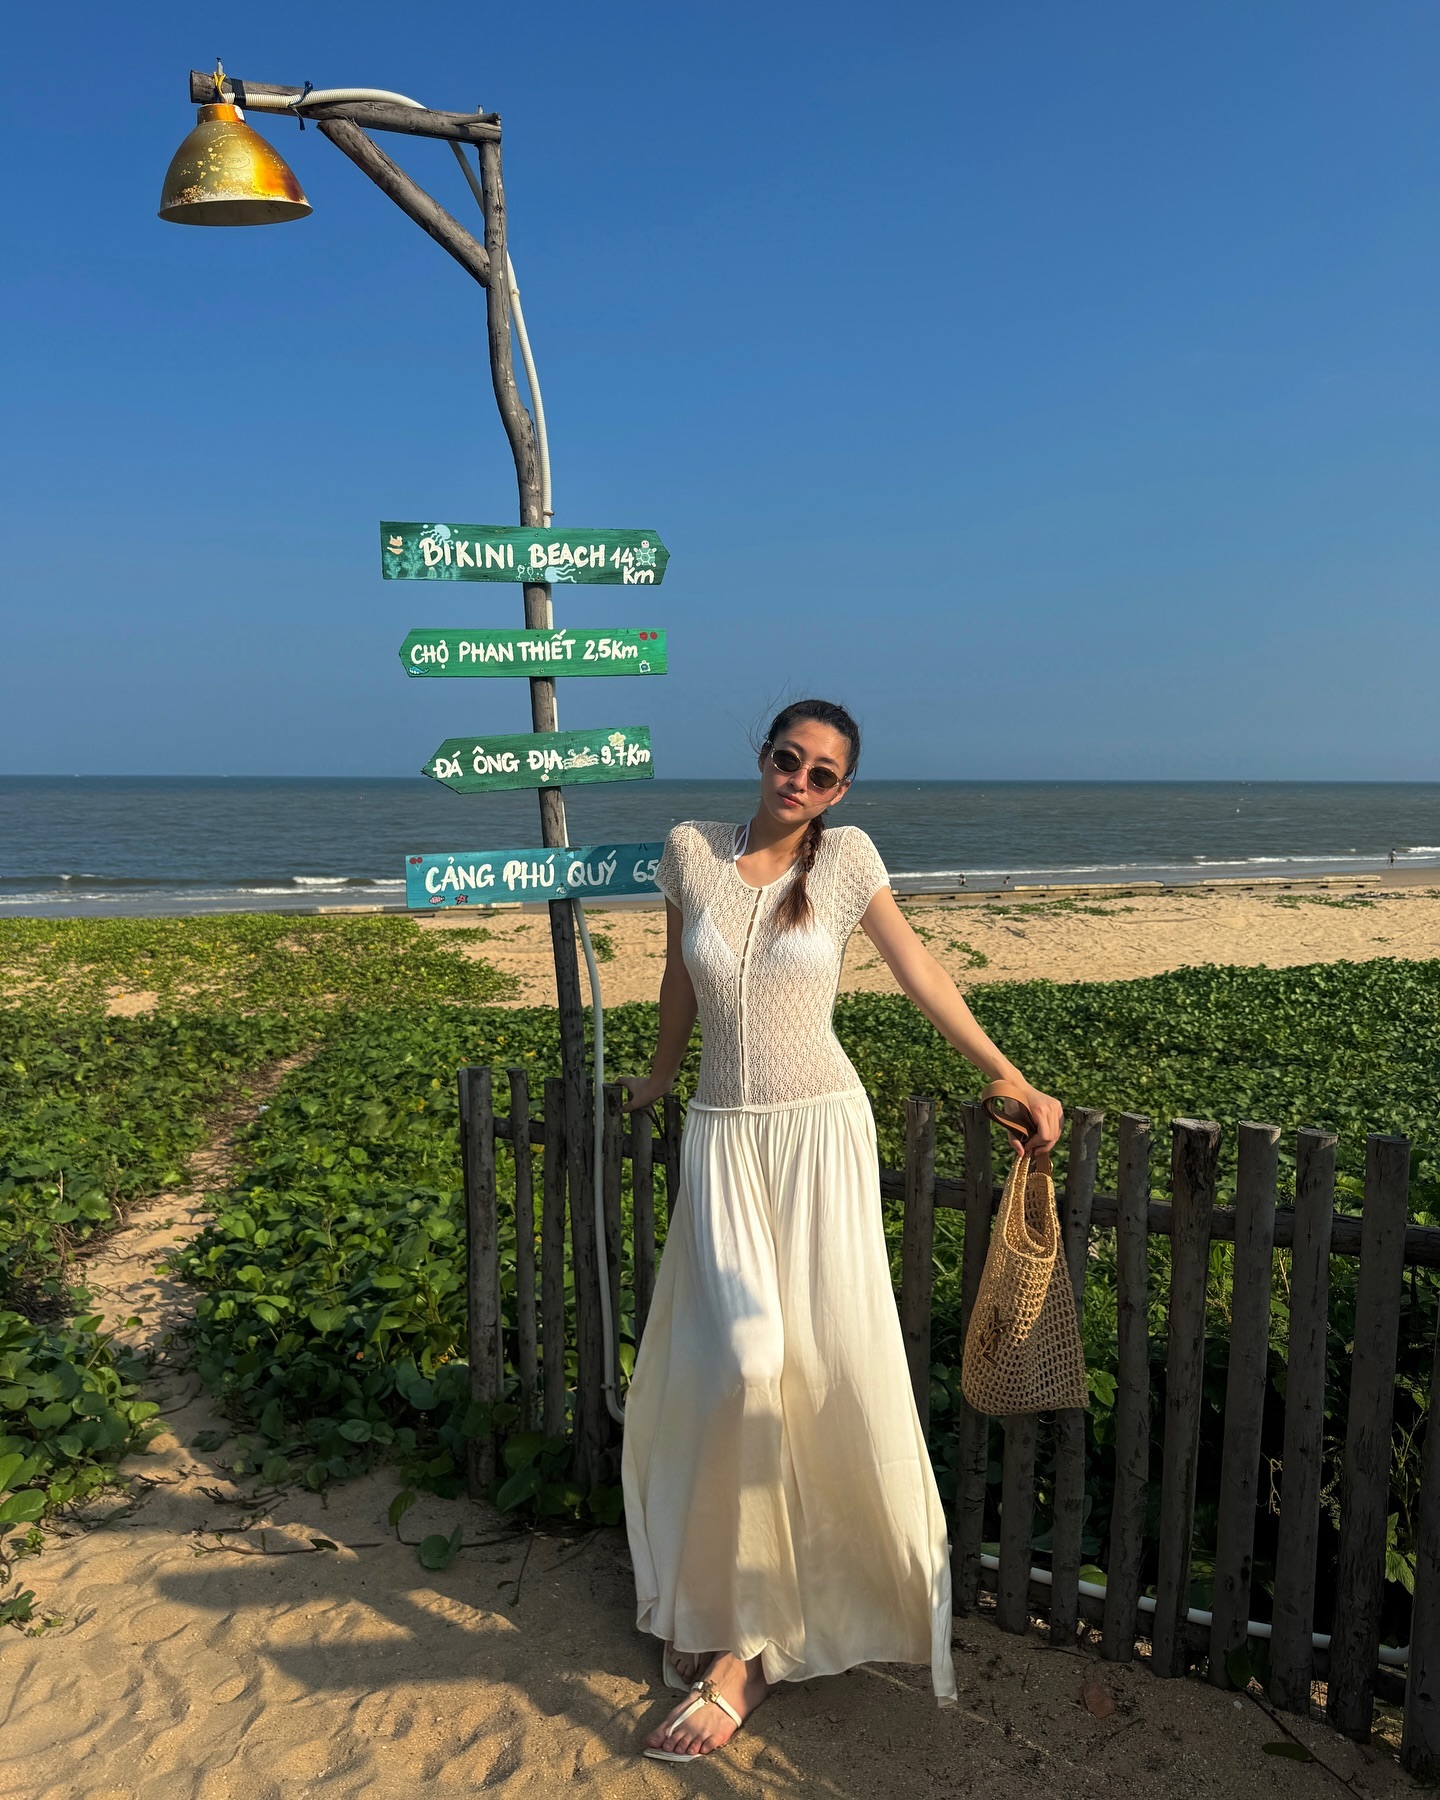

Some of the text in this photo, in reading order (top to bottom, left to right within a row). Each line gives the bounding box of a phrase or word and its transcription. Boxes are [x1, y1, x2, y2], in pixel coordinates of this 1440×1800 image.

[418, 537, 635, 570] BIKINI BEACH 14
[458, 641, 514, 663] PHAN
[516, 628, 577, 662] THIẾT
[582, 638, 638, 662] 2,5Km
[432, 751, 463, 779] ĐÁ
[472, 746, 520, 774] ÔNG
[526, 749, 563, 774] ĐỊA
[425, 857, 495, 893] CẢNG
[503, 854, 555, 891] PHÚ
[567, 849, 617, 887] QUÝ
